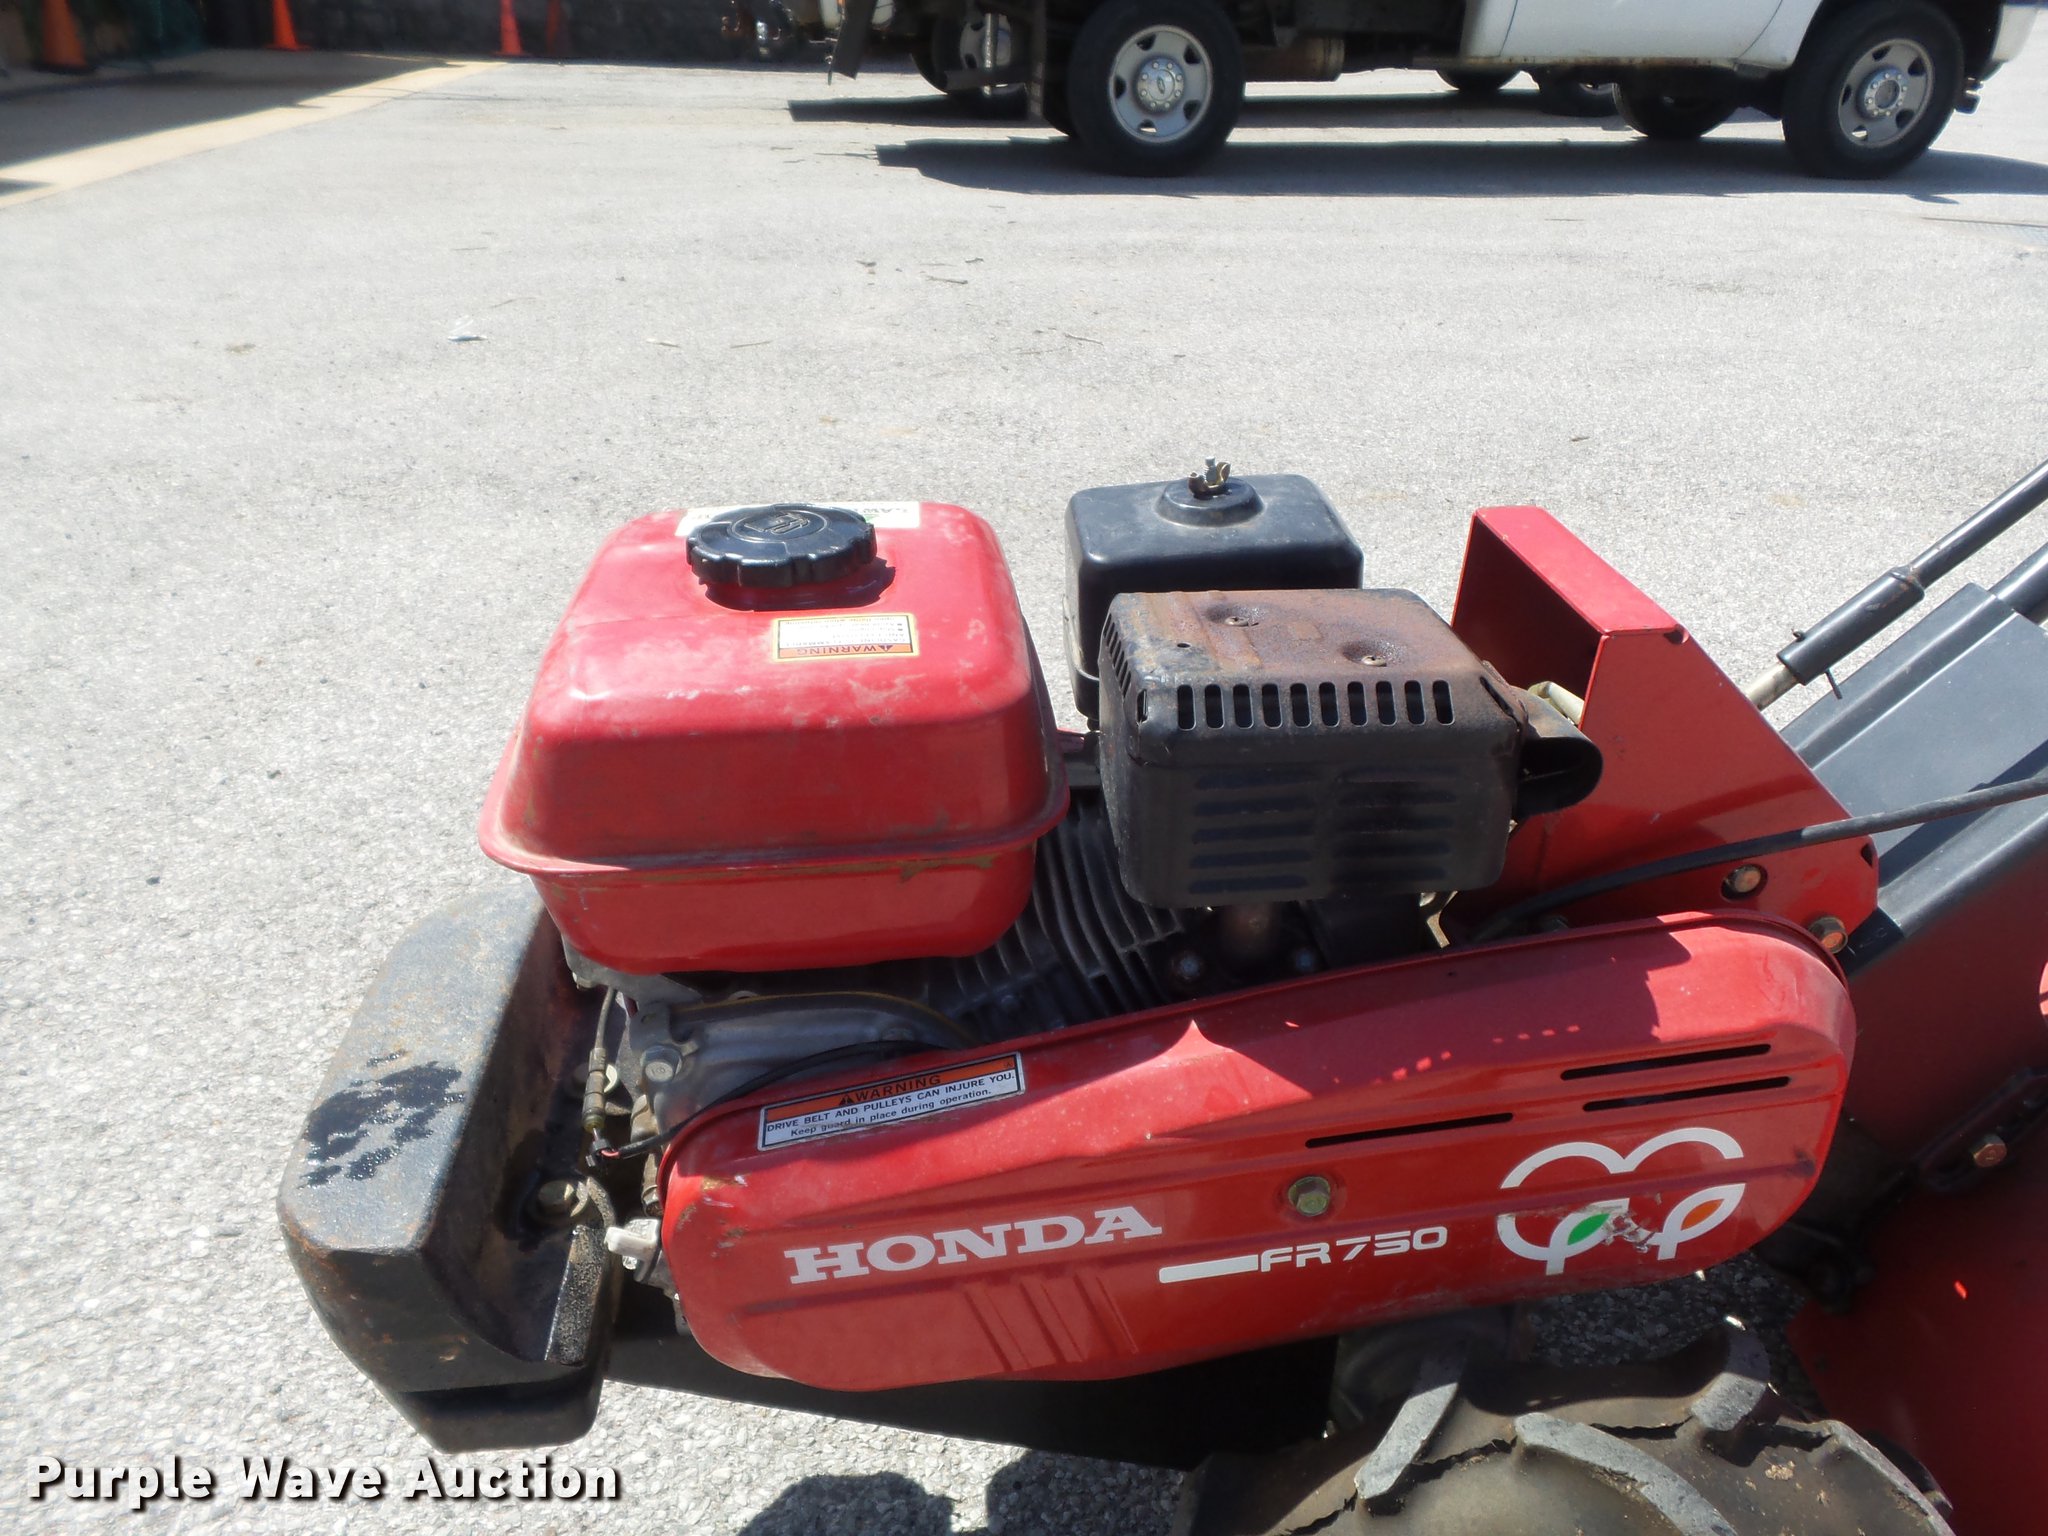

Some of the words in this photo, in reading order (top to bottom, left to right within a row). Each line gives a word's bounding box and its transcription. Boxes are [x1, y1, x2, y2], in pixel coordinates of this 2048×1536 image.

[797, 645, 877, 655] WARNING
[767, 1119, 799, 1132] DRIVE
[804, 1112, 830, 1126] BELT
[835, 1107, 858, 1118] AND
[863, 1095, 912, 1112] PULLEYS
[917, 1089, 940, 1100] CAN
[945, 1078, 985, 1094] INJURE
[989, 1072, 1015, 1083] YOU.
[855, 1075, 941, 1102] WARNING
[791, 1125, 817, 1137] Keep
[821, 1119, 851, 1132] guard
[856, 1116, 865, 1124] in
[870, 1110, 897, 1123] place
[901, 1101, 935, 1115] during
[940, 1089, 992, 1105] operation.
[784, 1206, 1162, 1285] HONDA
